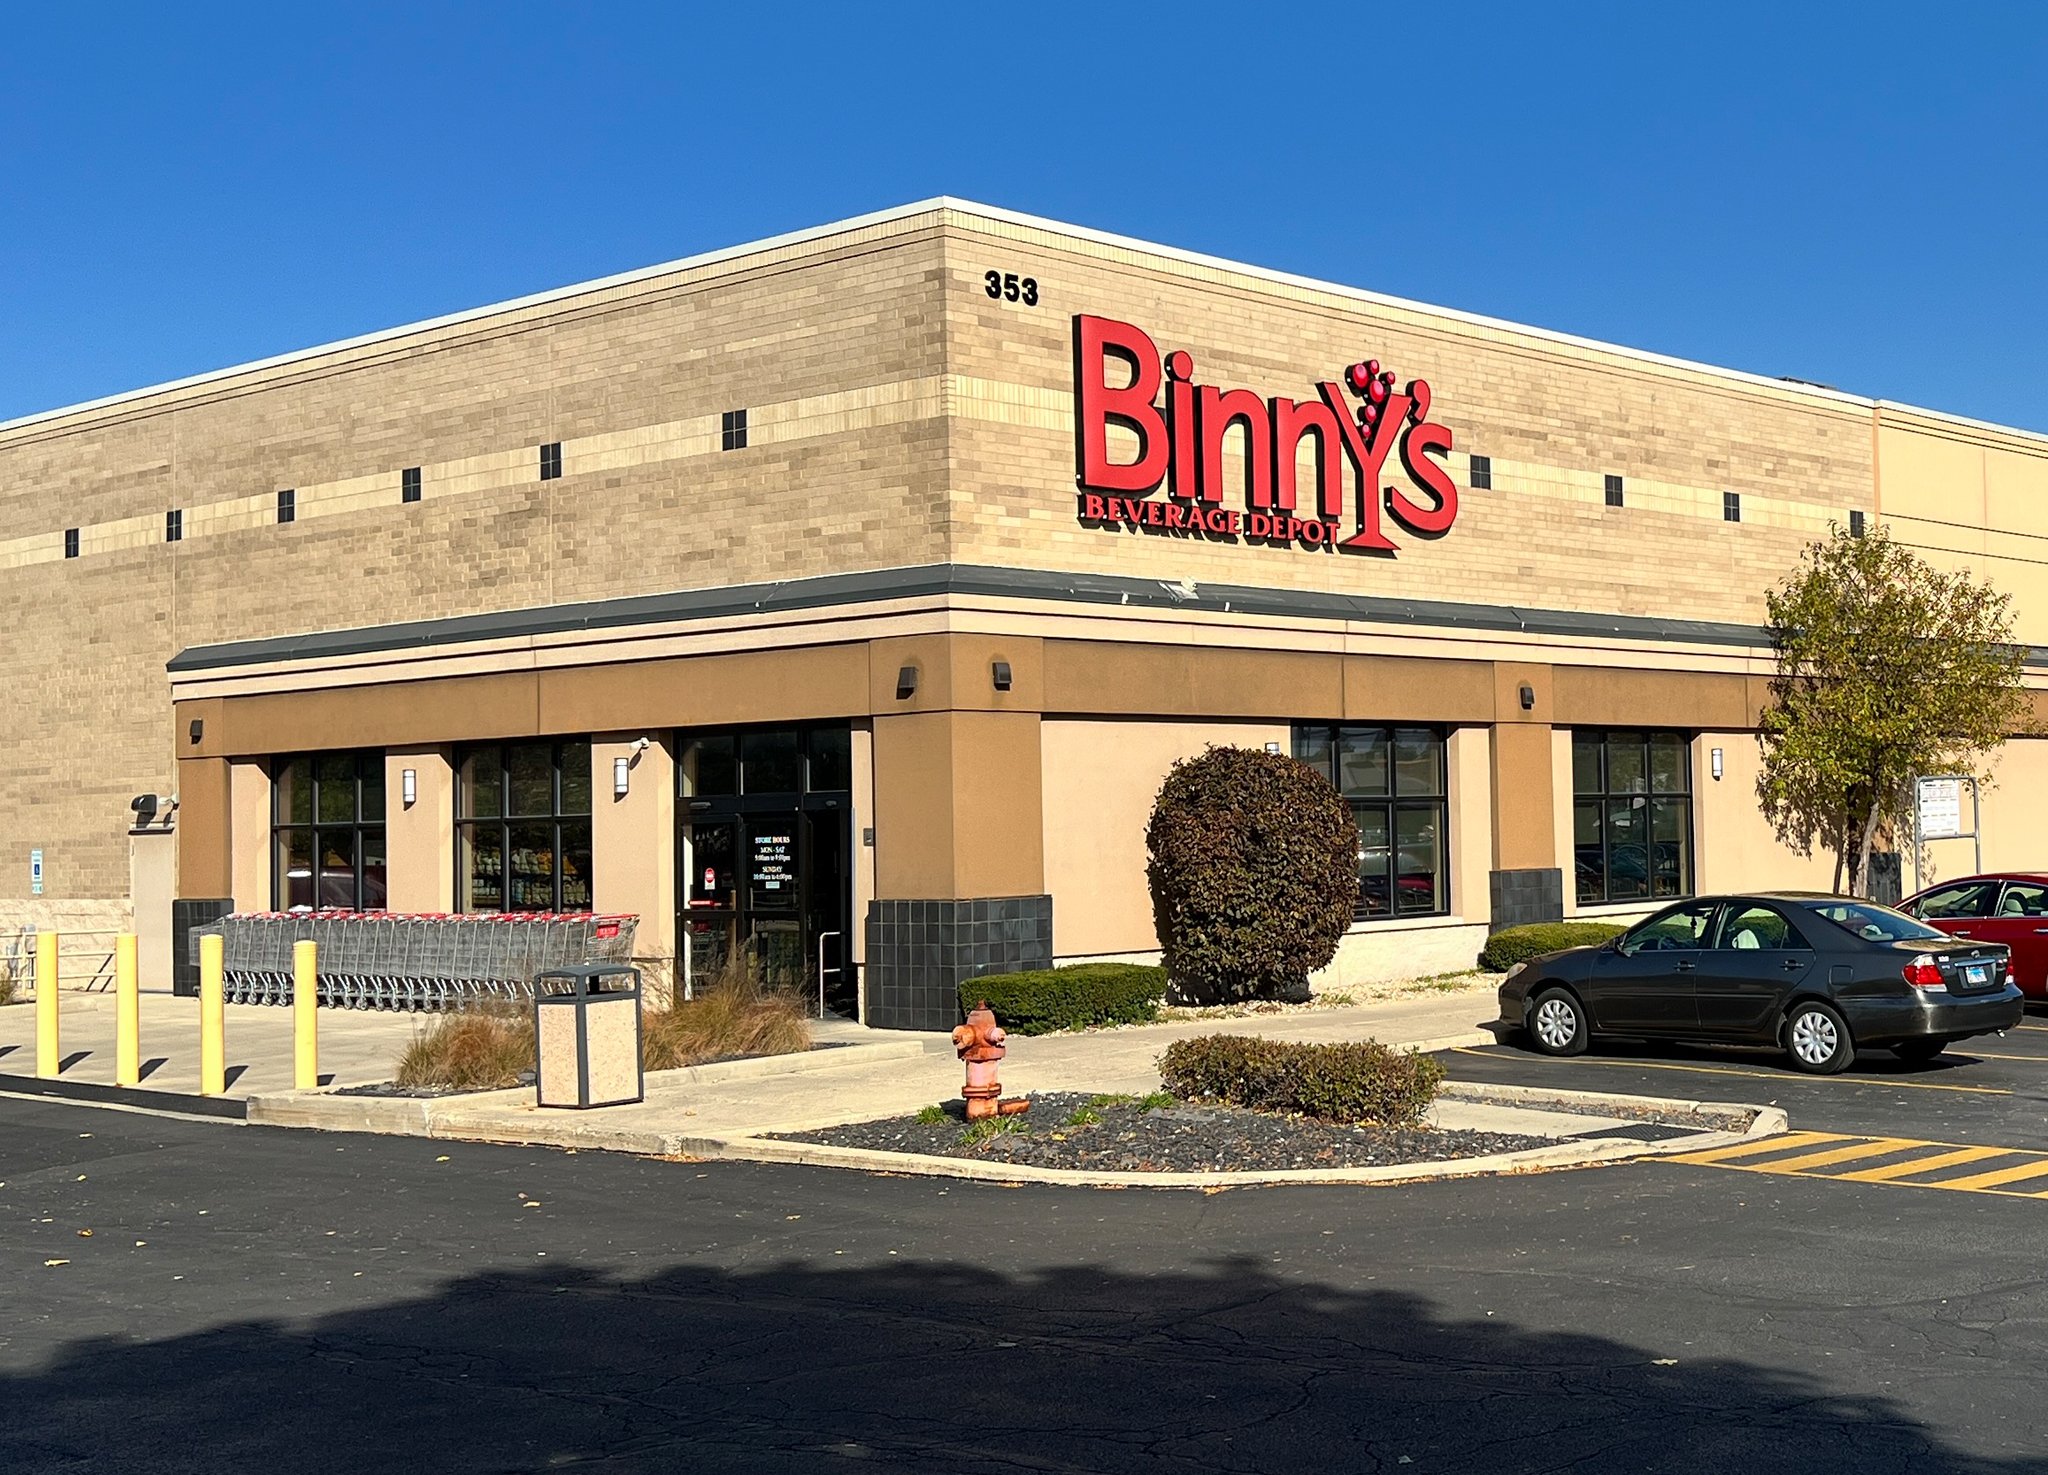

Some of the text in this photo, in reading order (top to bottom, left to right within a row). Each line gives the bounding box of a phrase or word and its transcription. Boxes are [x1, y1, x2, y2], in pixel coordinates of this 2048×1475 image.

[984, 270, 1039, 307] 353
[1082, 494, 1341, 544] BEVERAGE DEPOT
